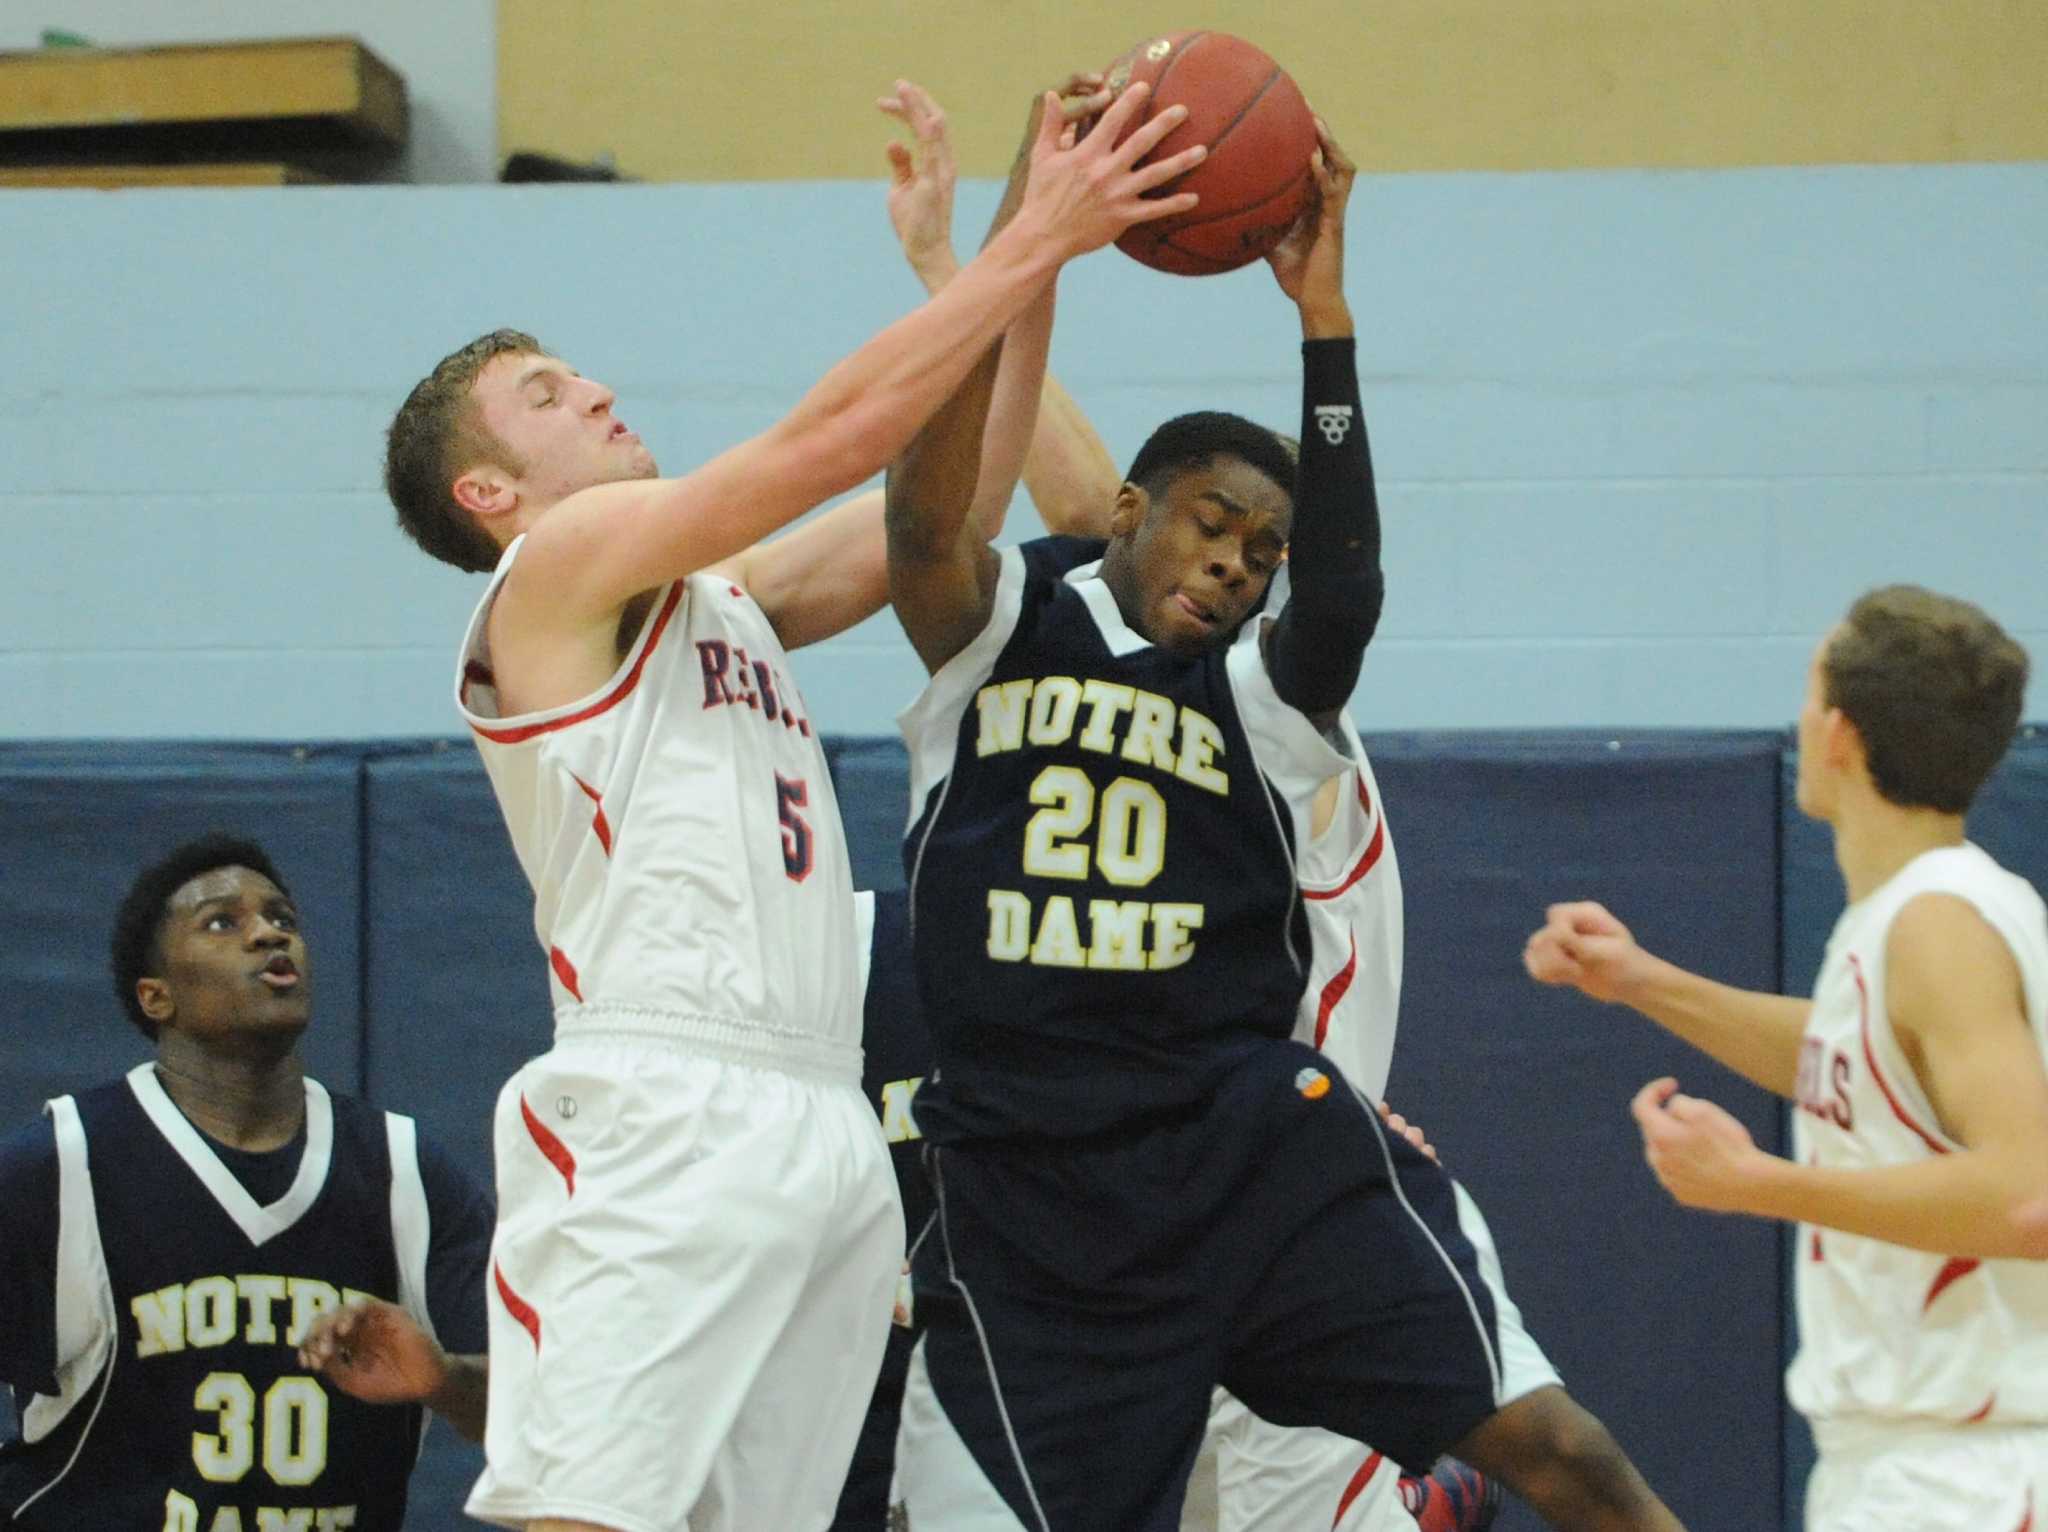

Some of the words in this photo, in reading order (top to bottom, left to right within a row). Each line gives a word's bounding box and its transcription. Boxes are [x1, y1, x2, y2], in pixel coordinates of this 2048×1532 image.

[976, 675, 1229, 797] NOTRE
[774, 768, 814, 882] 5
[1023, 764, 1167, 887] 20
[987, 889, 1204, 970] DAME
[131, 1273, 390, 1360] NOTR
[192, 1371, 329, 1486] 30
